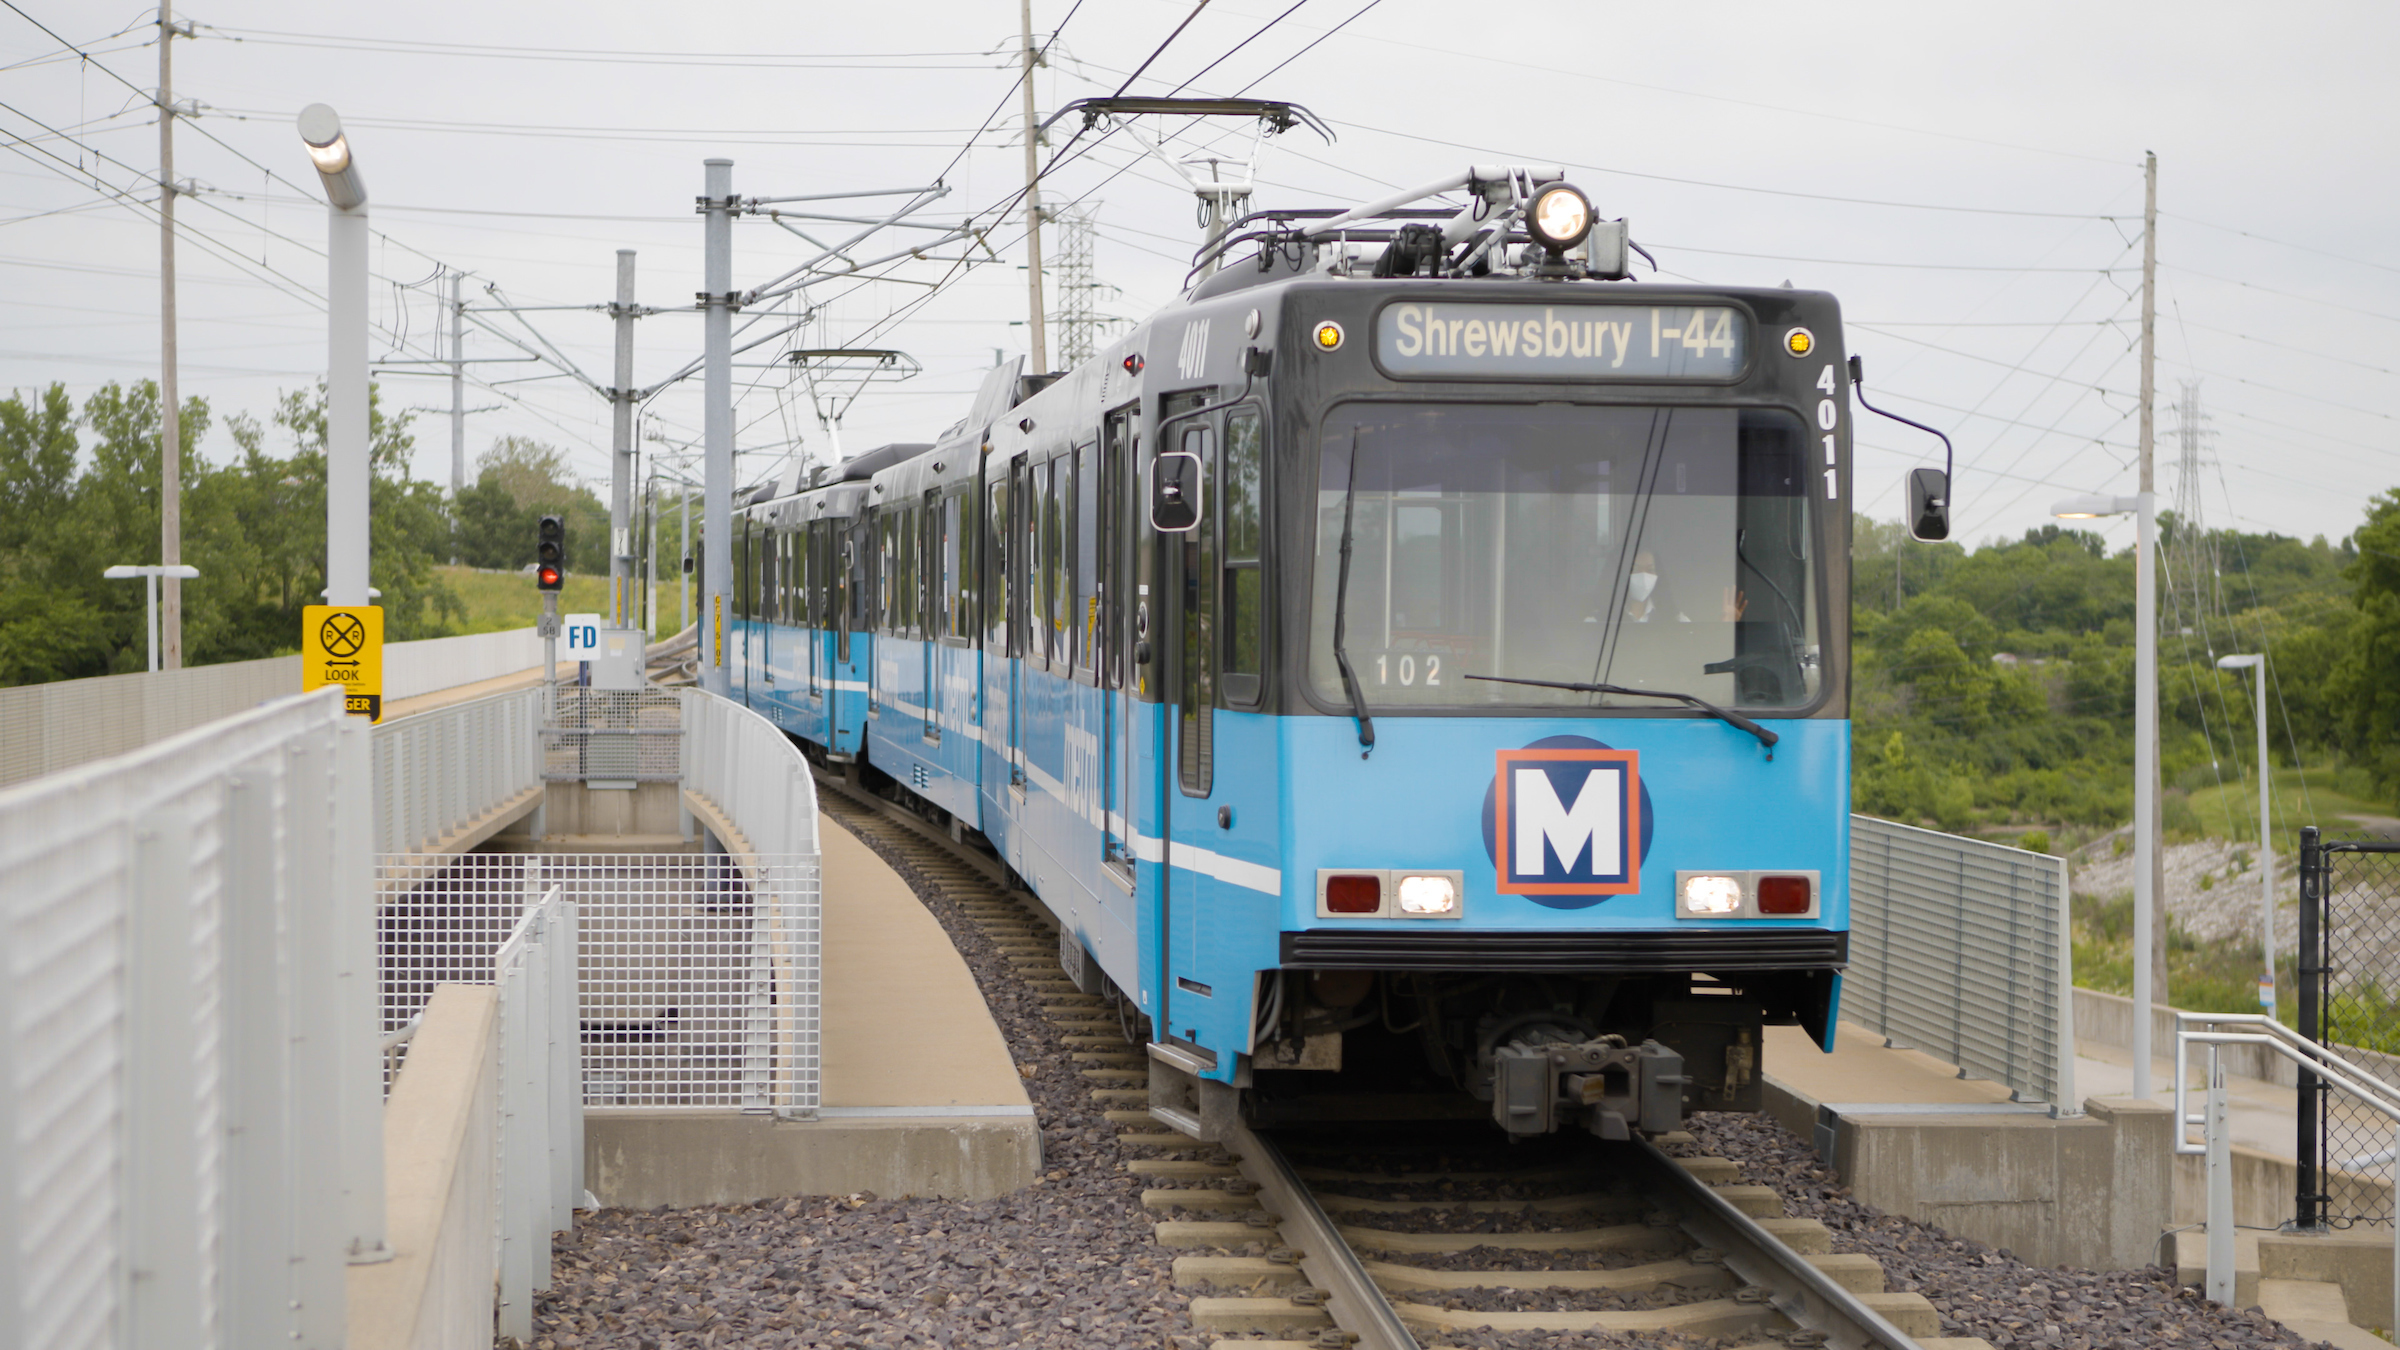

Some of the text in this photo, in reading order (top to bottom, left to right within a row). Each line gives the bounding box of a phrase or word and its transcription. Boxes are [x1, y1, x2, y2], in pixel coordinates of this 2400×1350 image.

[1178, 318, 1210, 380] 4011
[1395, 305, 1735, 368] Shrewsbury I-44
[1816, 364, 1838, 500] 4011
[326, 631, 360, 640] R R
[569, 626, 597, 649] FD
[325, 669, 360, 681] LOOK
[1376, 655, 1441, 686] 102
[345, 698, 371, 710] GER
[1515, 768, 1621, 876] M
